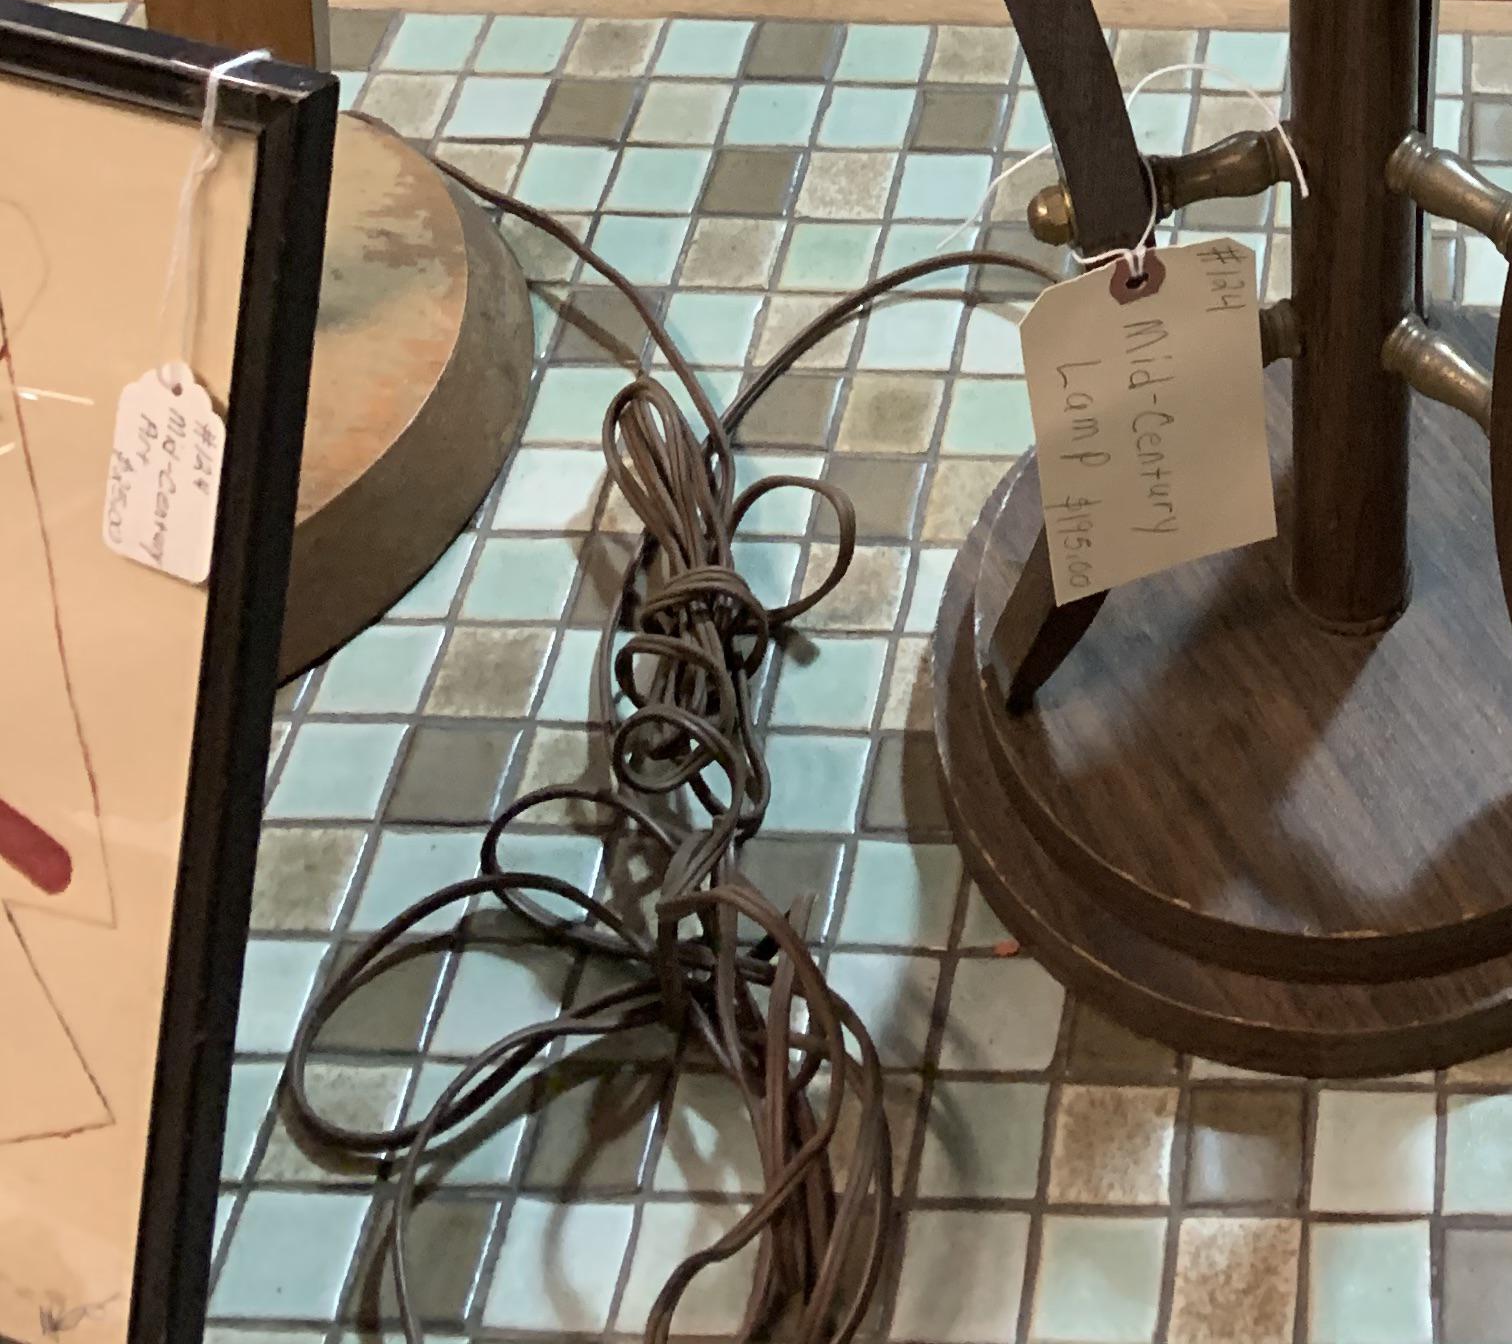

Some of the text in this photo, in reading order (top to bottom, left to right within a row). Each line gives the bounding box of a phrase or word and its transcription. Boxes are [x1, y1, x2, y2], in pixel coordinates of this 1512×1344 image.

[1196, 245, 1248, 313] #124
[1055, 358, 1112, 468] Lamp
[1122, 317, 1179, 536] Mid-Century
[1044, 494, 1103, 590] $195.00
